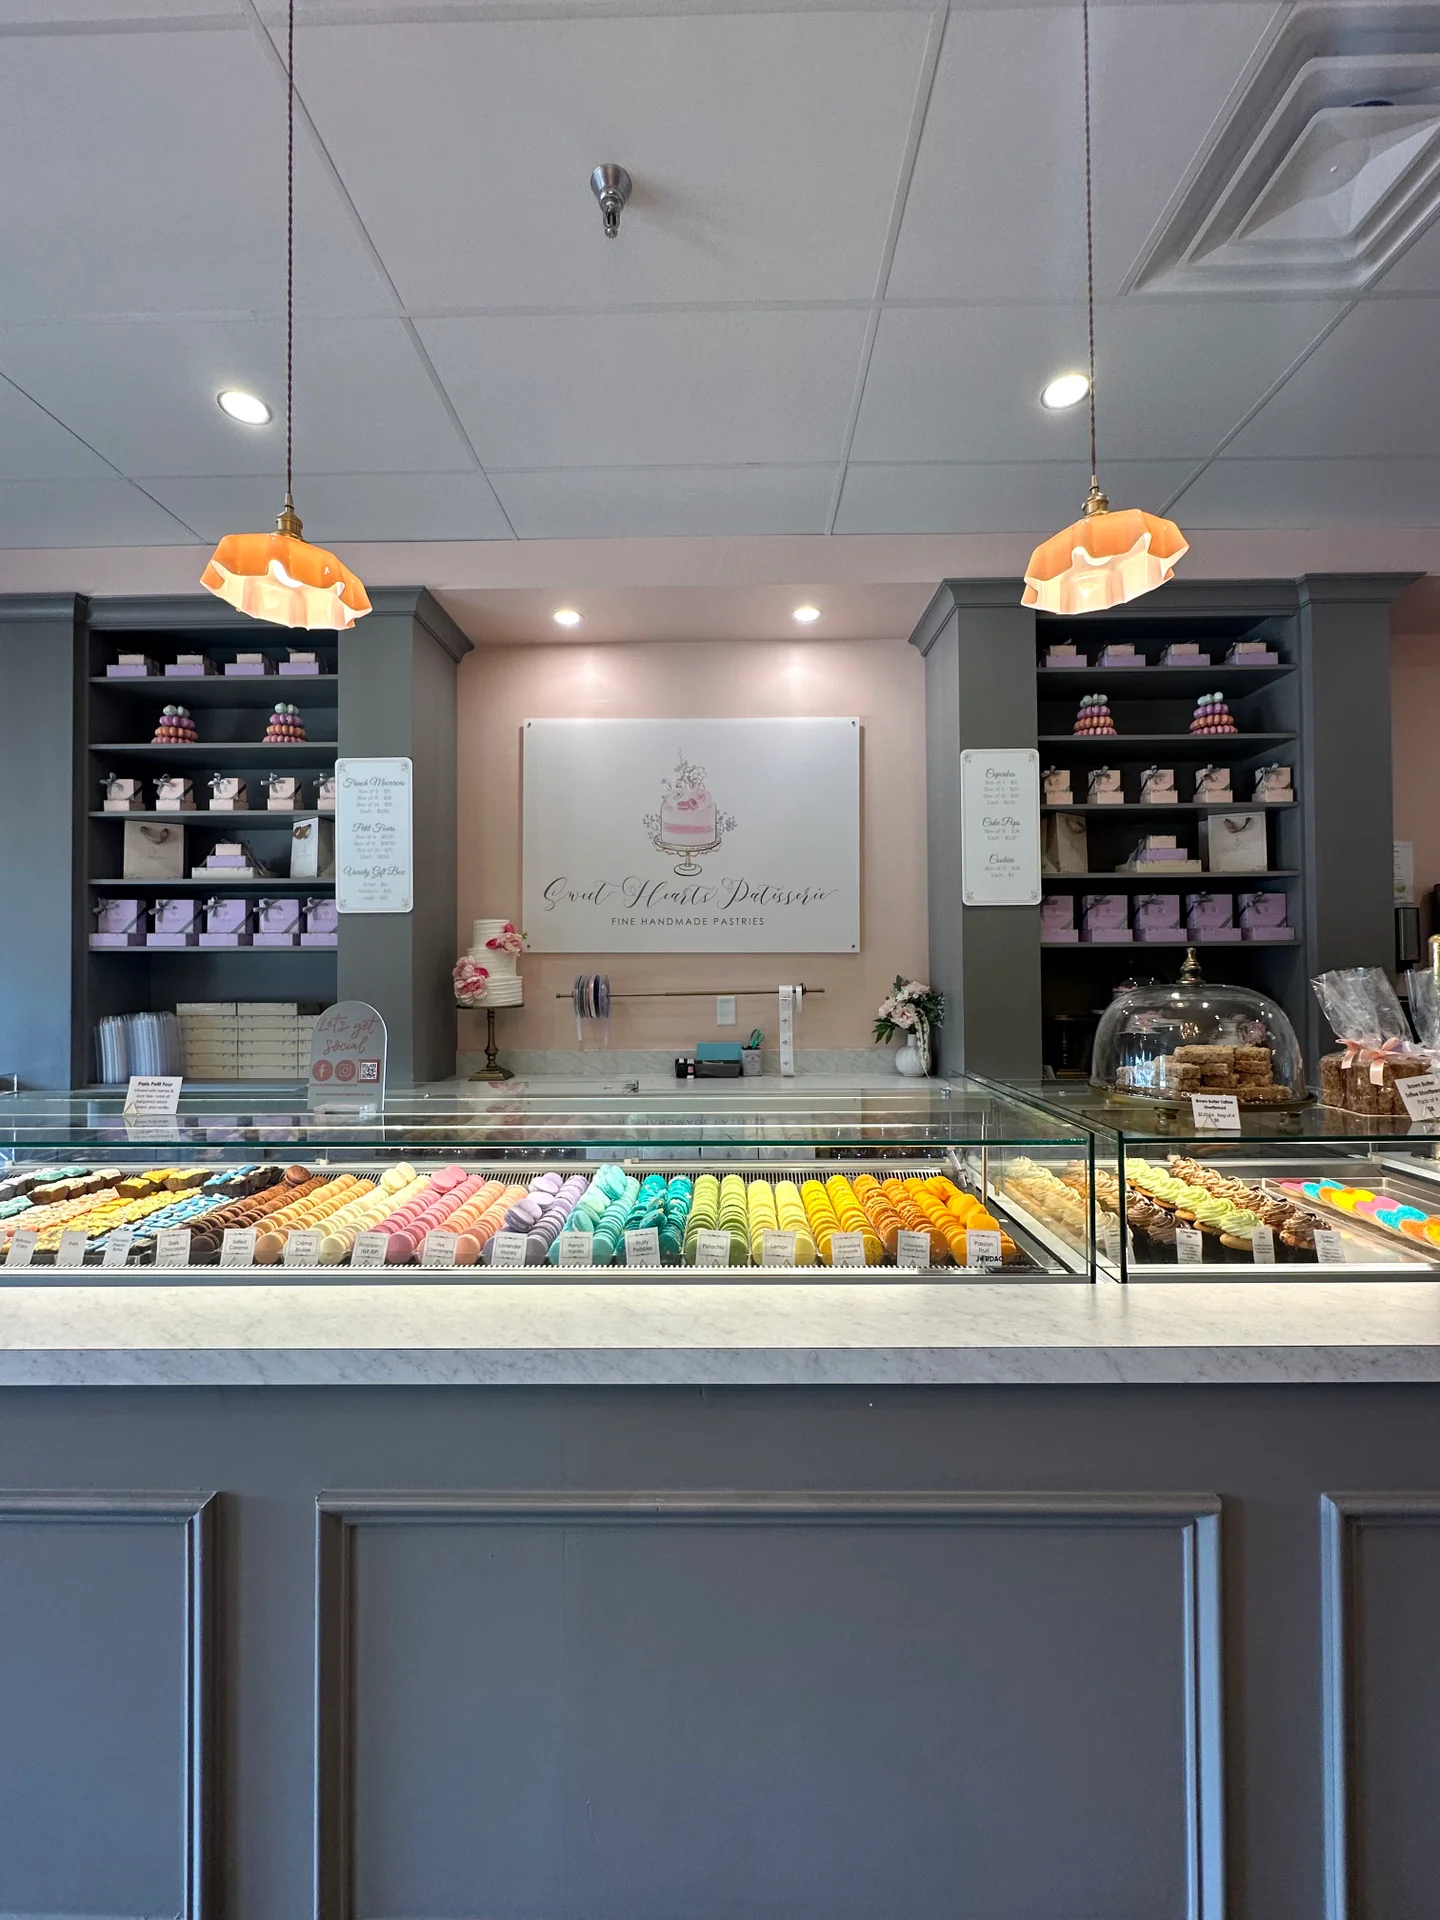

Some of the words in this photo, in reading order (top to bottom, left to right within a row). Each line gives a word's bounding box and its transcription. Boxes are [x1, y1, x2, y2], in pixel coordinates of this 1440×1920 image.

[982, 816, 1001, 827] Cake
[544, 877, 621, 911] Sweet
[622, 876, 719, 909] Hearts
[717, 877, 838, 910] Patisserie
[611, 918, 636, 926] FINE
[641, 918, 708, 926] HANDMADE
[713, 918, 765, 926] PASTRIES
[350, 1015, 381, 1039] get
[702, 1243, 725, 1251] Pistachio
